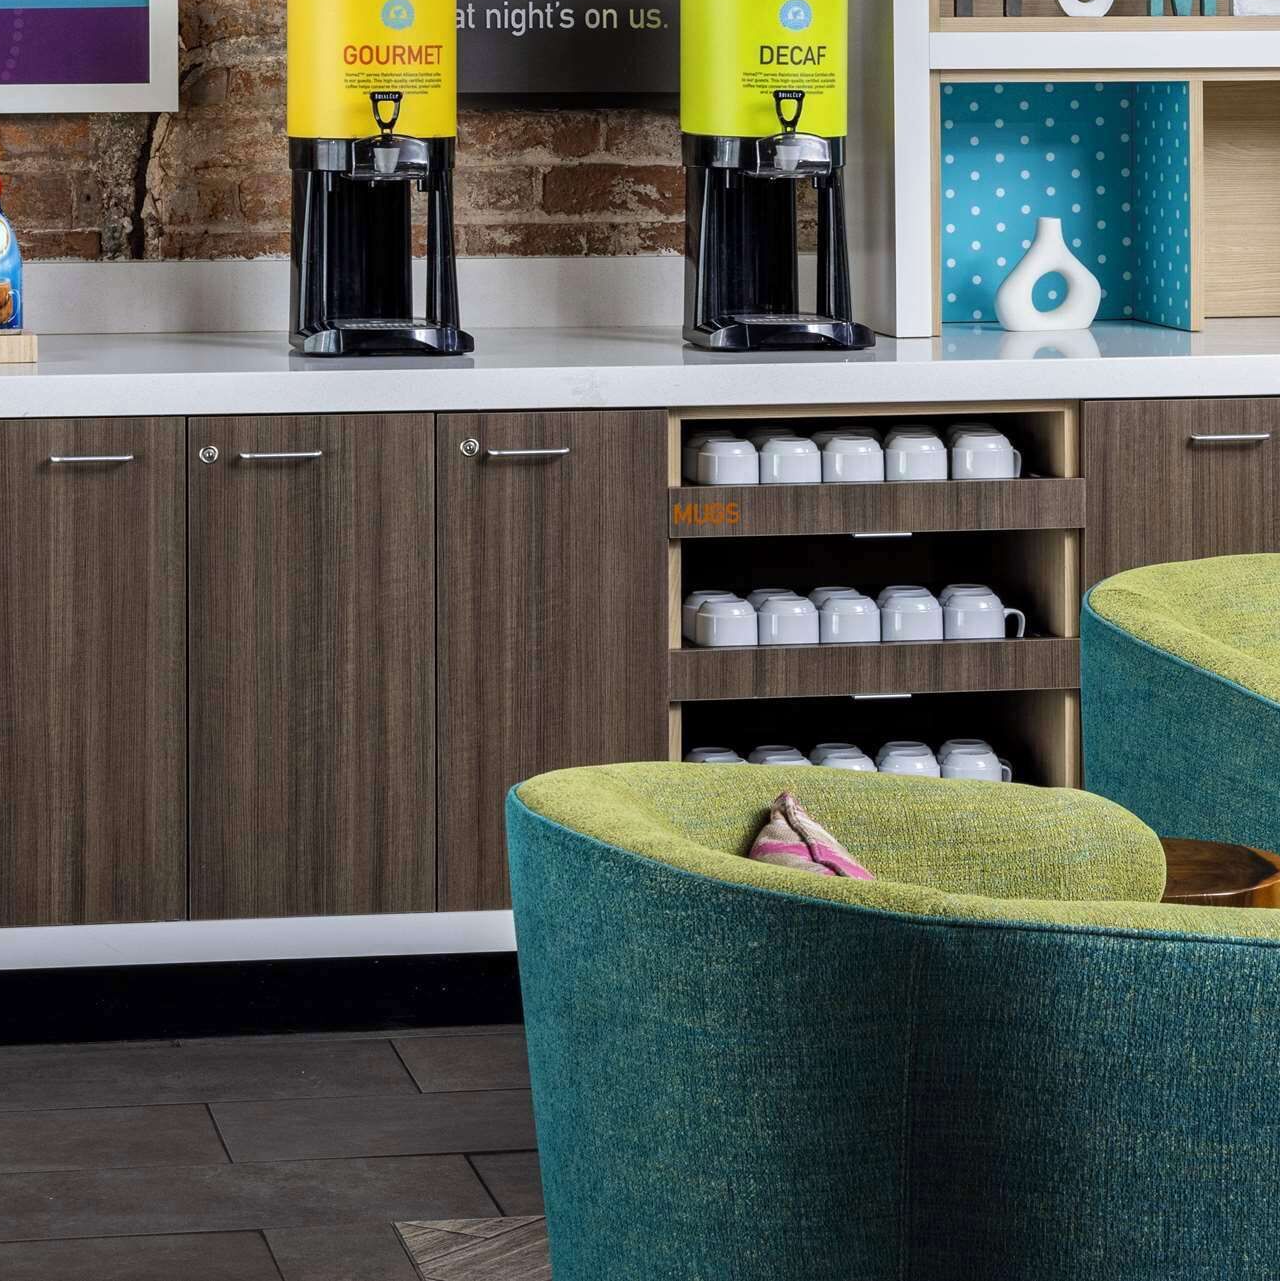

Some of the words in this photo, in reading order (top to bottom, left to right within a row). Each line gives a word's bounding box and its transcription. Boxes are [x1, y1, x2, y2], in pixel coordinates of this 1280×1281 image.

[486, 1, 575, 37] night's
[585, 9, 618, 29] on
[629, 8, 669, 29] us.
[343, 44, 443, 65] GOURMET
[759, 45, 827, 65] DECAF
[673, 502, 740, 526] MUGS
